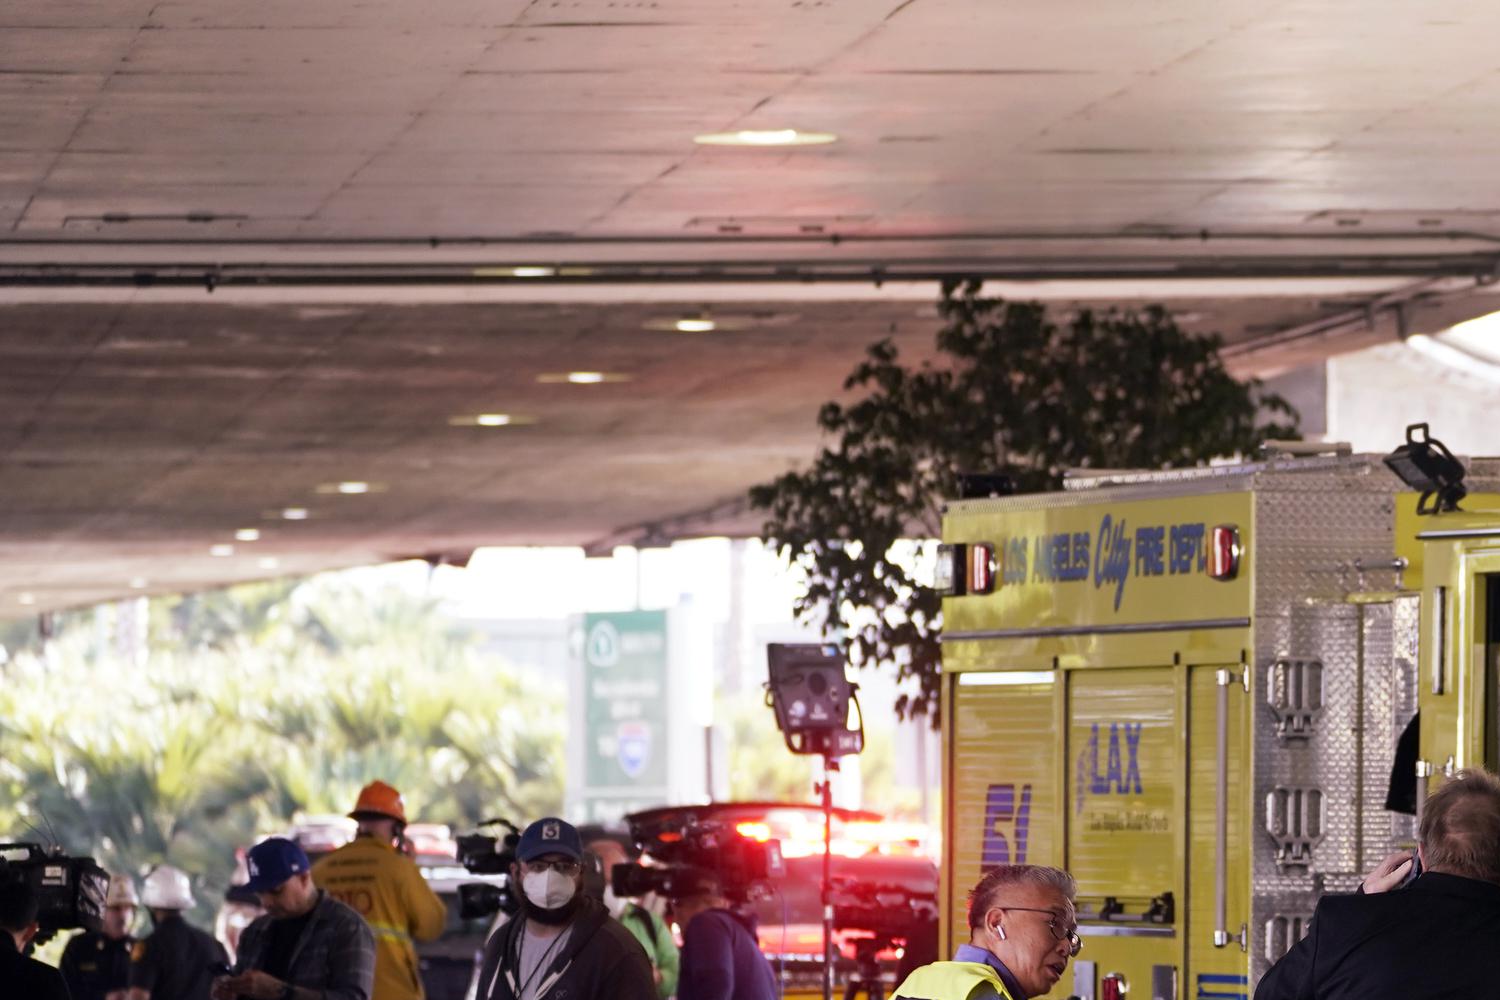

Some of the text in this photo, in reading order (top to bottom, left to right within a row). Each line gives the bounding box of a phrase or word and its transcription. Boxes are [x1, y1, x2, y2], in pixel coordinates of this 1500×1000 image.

[1003, 536, 1027, 585] LOS
[1032, 531, 1091, 584] ANGELES
[1095, 513, 1132, 612] City
[1135, 526, 1166, 577] FIRE
[1090, 722, 1143, 794] LAX
[981, 784, 1032, 872] 51
